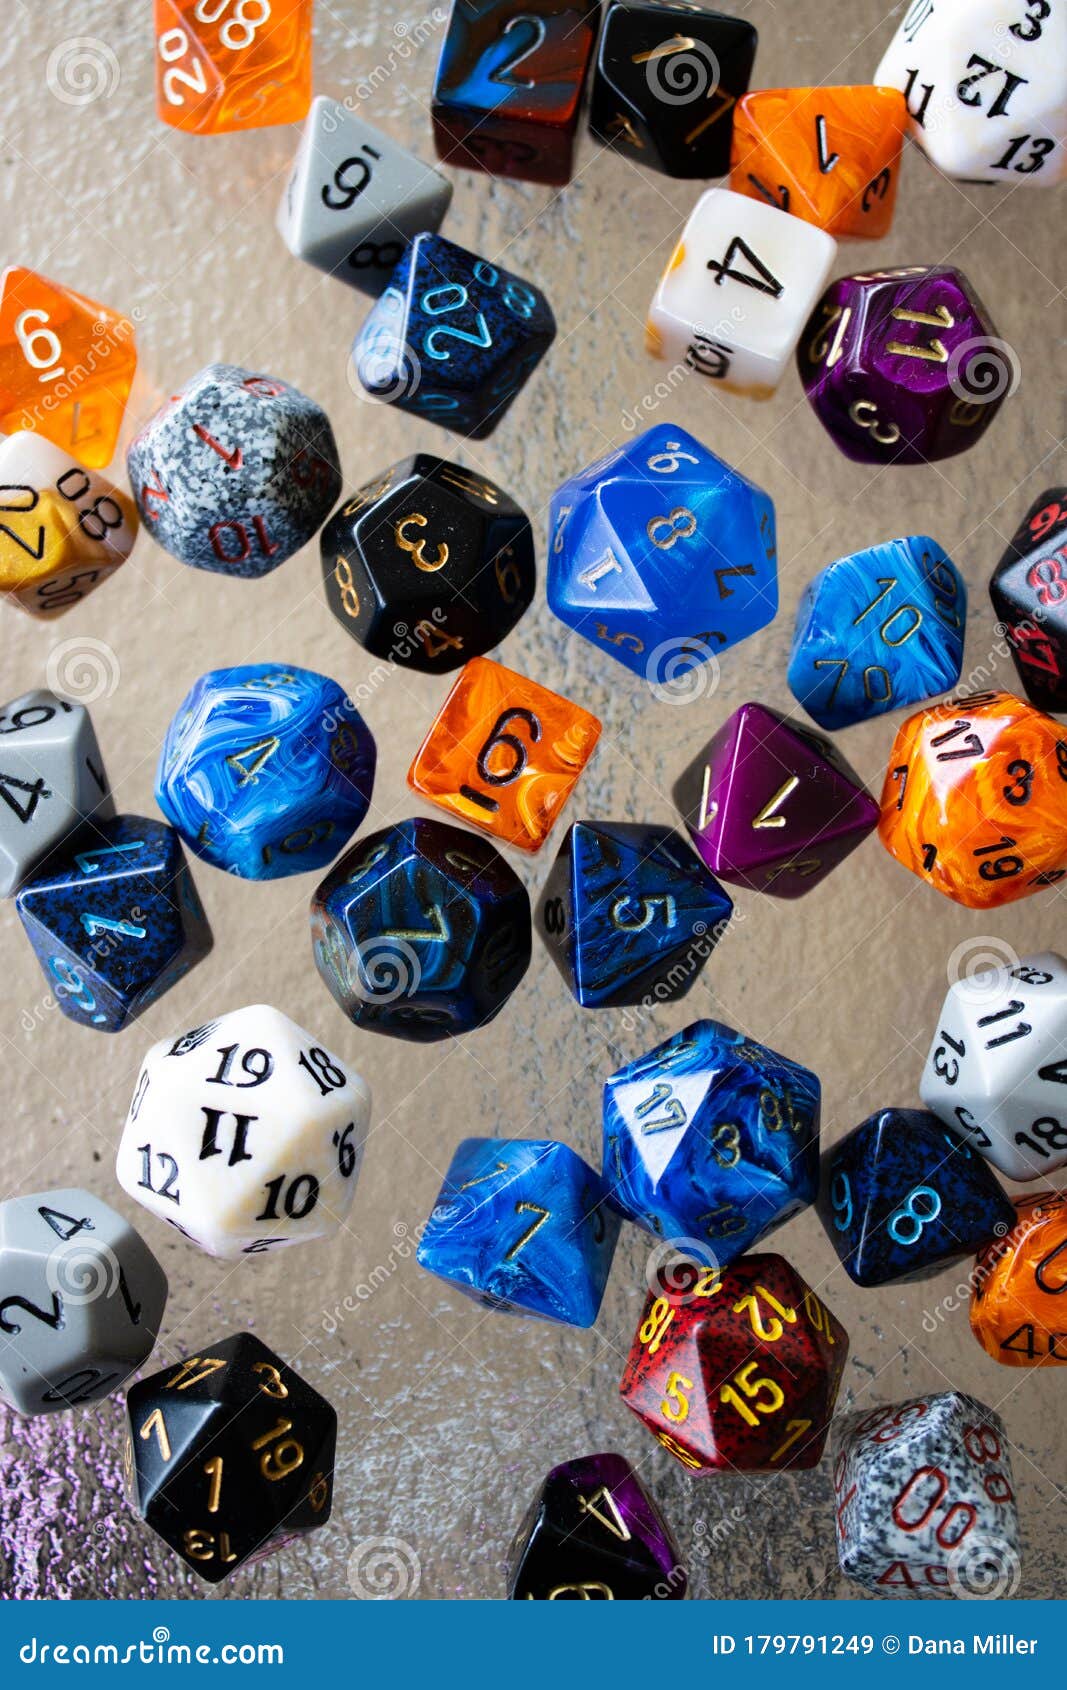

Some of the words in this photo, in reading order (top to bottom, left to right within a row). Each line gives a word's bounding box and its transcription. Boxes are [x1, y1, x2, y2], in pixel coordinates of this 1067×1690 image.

[158, 27, 208, 107] 20
[503, 14, 546, 89] 2
[956, 52, 1030, 119] 12
[989, 133, 1056, 174] 13
[706, 235, 785, 300] 4
[418, 282, 493, 361] 20
[885, 304, 957, 364] 11
[848, 399, 902, 445] 3
[55, 467, 125, 542] 80
[647, 505, 697, 550] 8
[208, 514, 281, 564] 10
[394, 512, 450, 573] 3
[333, 553, 362, 618] 8
[577, 546, 623, 593] 1
[713, 563, 757, 601] 7
[852, 576, 925, 649] 10
[813, 657, 893, 710] 70
[224, 735, 282, 789] 4
[930, 719, 985, 763] 17
[0, 771, 53, 826] 4
[1003, 758, 1036, 807] 3
[973, 835, 1025, 882] 19
[543, 896, 566, 936] 8
[608, 894, 678, 933] 5
[976, 999, 1033, 1051] 11
[205, 1042, 276, 1088] 19
[298, 1047, 347, 1097] 18
[932, 1030, 967, 1086] 13
[634, 1082, 688, 1136] 17
[954, 1106, 993, 1148] 5
[198, 1106, 259, 1167] 11
[710, 1122, 742, 1170] 3
[1014, 1116, 1067, 1159] 18
[136, 1143, 182, 1206] 12
[255, 1173, 321, 1222] 10
[37, 1205, 96, 1241] 4
[887, 1185, 943, 1246] 8
[0, 1295, 67, 1335] 2
[732, 1285, 798, 1342] 12
[252, 1361, 290, 1399] 3
[659, 1371, 694, 1424] 5
[719, 1361, 785, 1427] 15
[252, 1416, 305, 1482] 19
[769, 1419, 813, 1463] 7
[962, 1423, 1014, 1504] 80
[203, 1455, 224, 1514] 1
[891, 1465, 978, 1550] 00
[576, 1486, 632, 1542] 4
